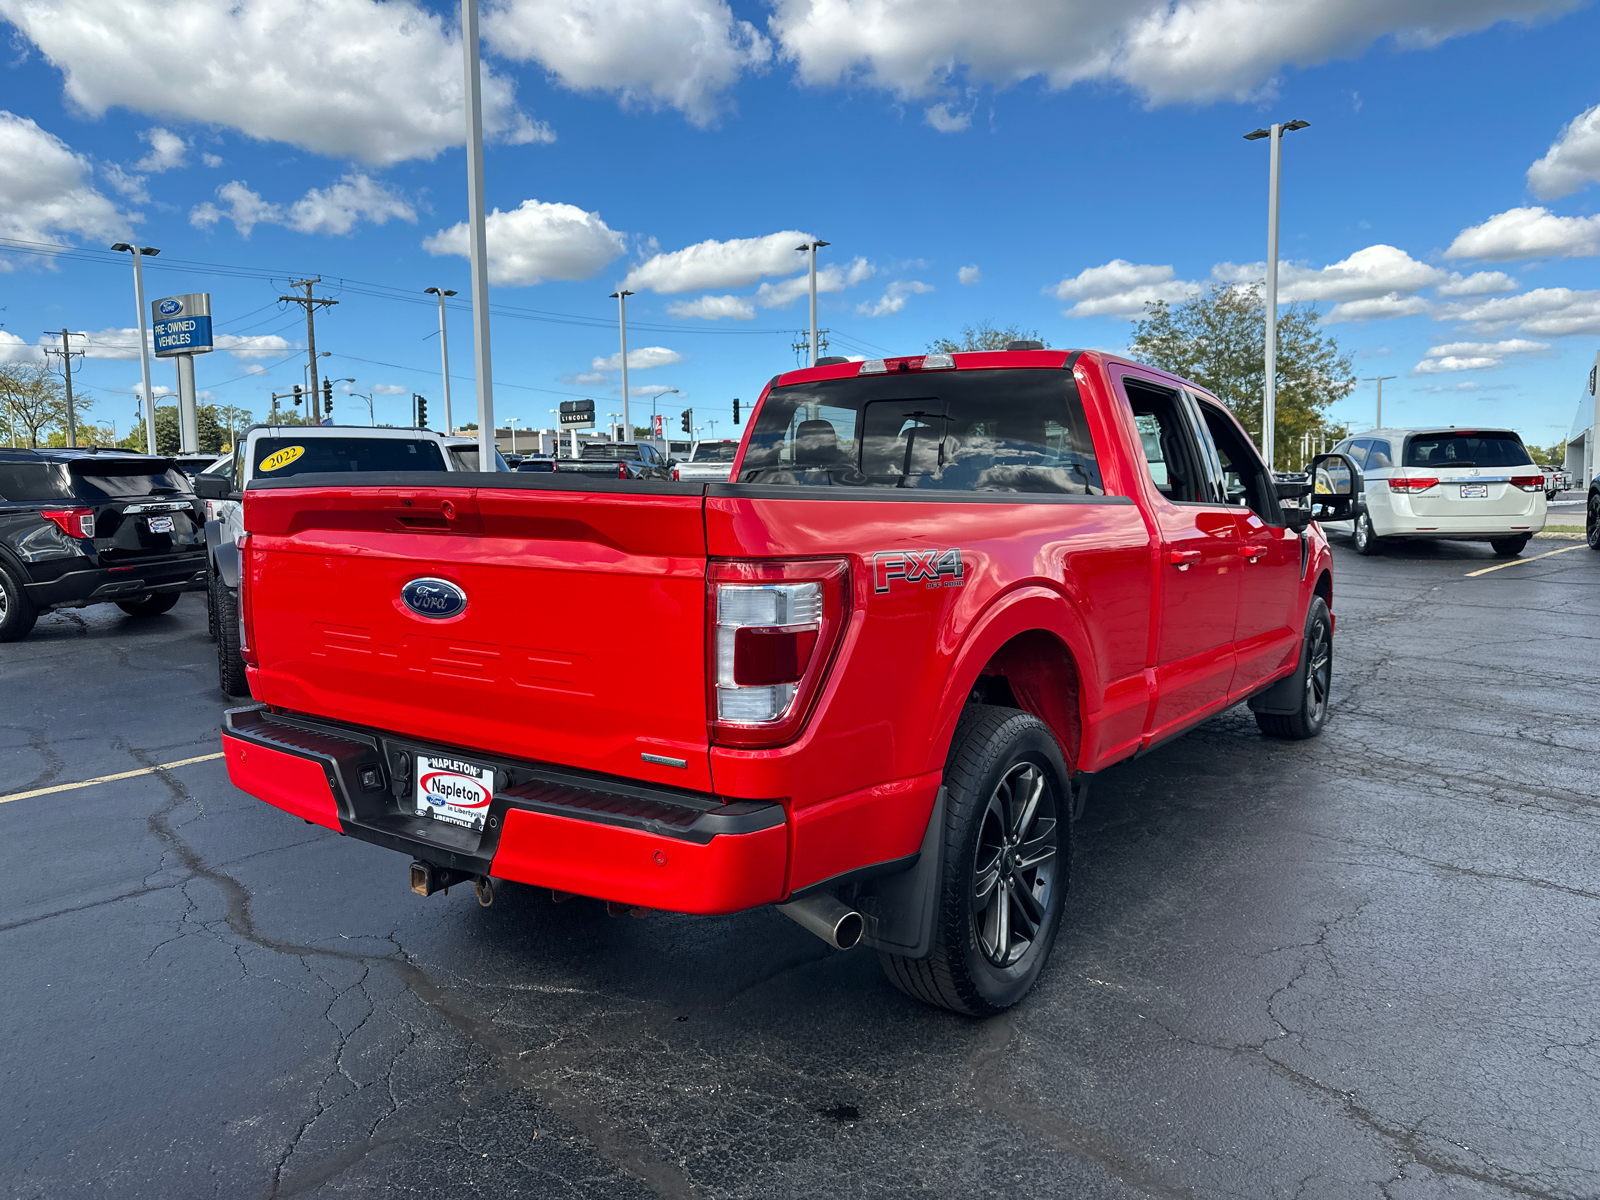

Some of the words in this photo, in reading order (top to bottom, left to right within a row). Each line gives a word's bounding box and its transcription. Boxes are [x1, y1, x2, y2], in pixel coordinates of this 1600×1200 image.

[155, 320, 196, 336] PRE-OWNED
[158, 333, 191, 347] VEHICLES
[561, 414, 588, 422] LINCOLN
[269, 447, 298, 468] 2022
[872, 548, 965, 594] FX4
[413, 586, 448, 610] Ford
[431, 758, 477, 776] NAPLETON
[432, 777, 480, 802] Napleton
[433, 813, 472, 829] LIBERTYVILLE
[454, 807, 486, 820] Libertyville
